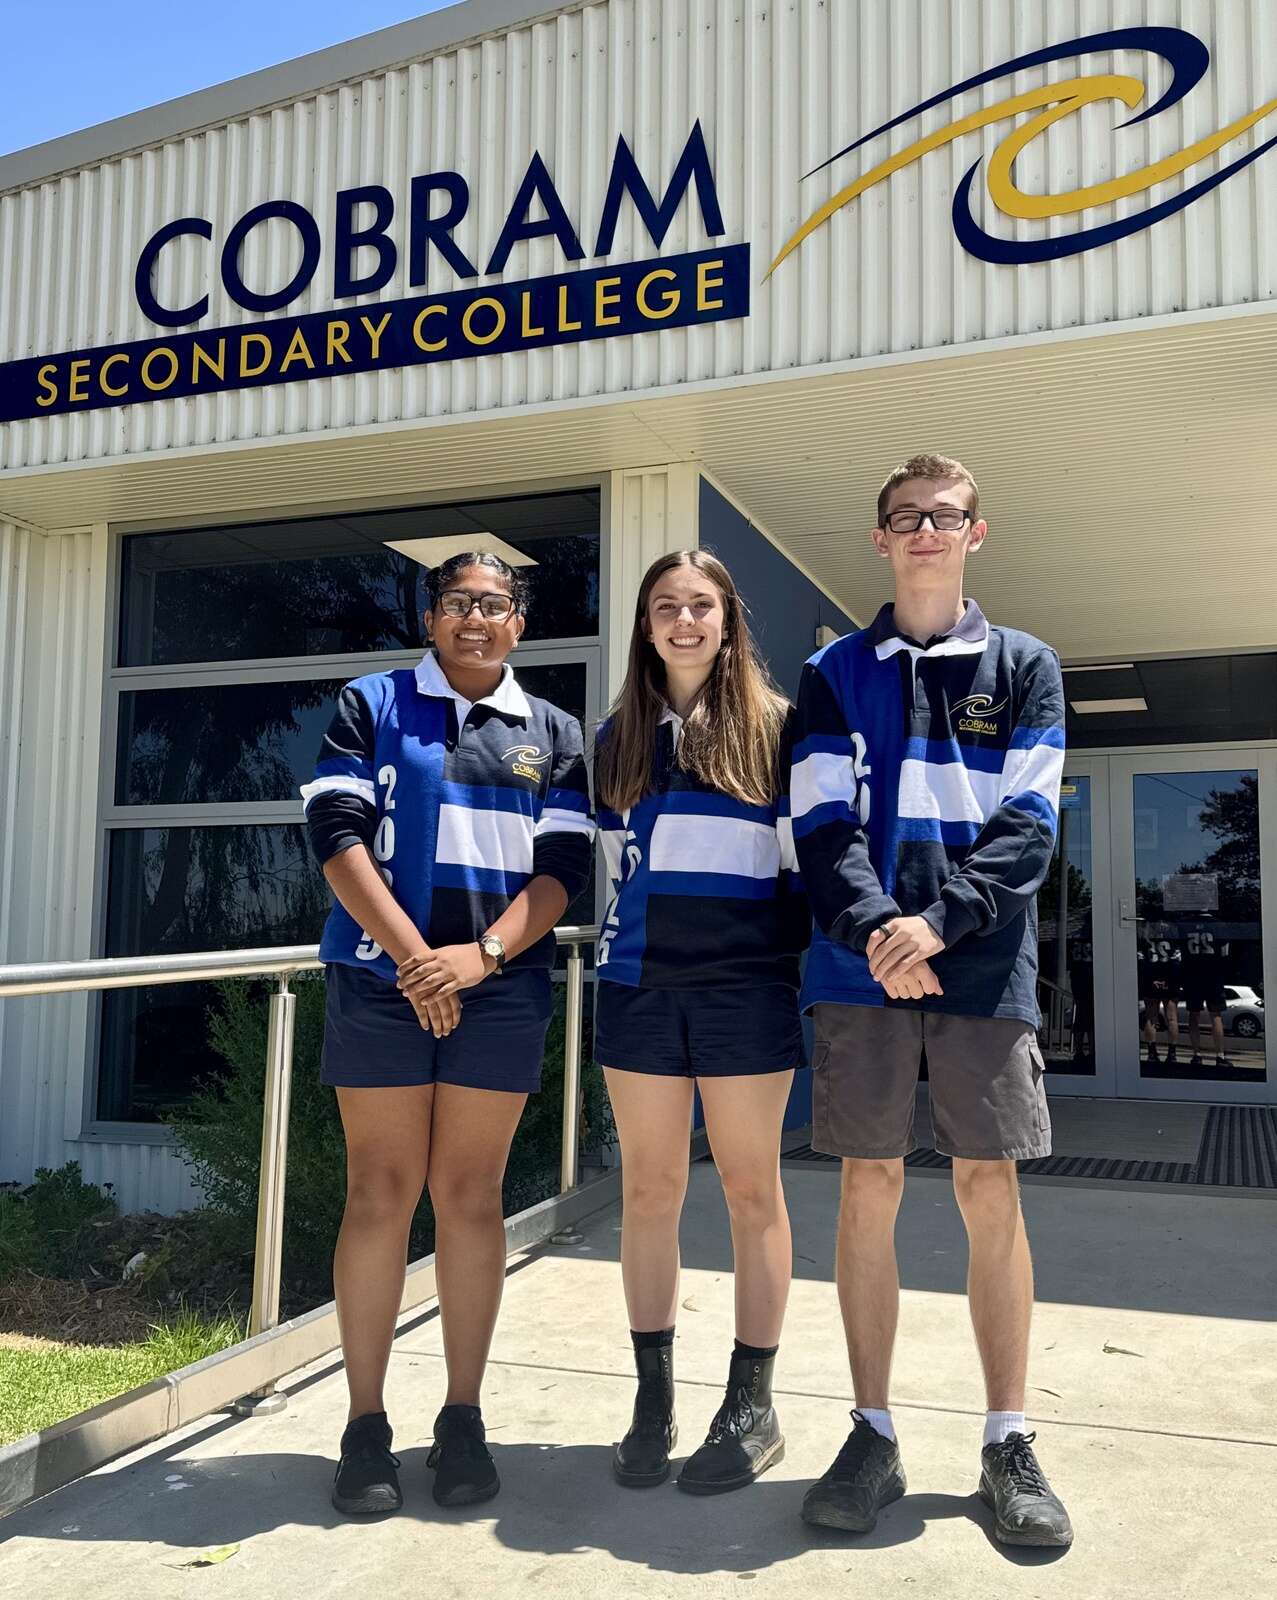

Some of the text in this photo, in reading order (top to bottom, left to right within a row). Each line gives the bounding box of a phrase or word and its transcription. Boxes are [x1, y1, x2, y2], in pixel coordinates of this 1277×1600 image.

[135, 117, 726, 328] COBRAM
[35, 259, 724, 407] SECONDARY COLLEGE
[958, 718, 997, 731] COBRAM
